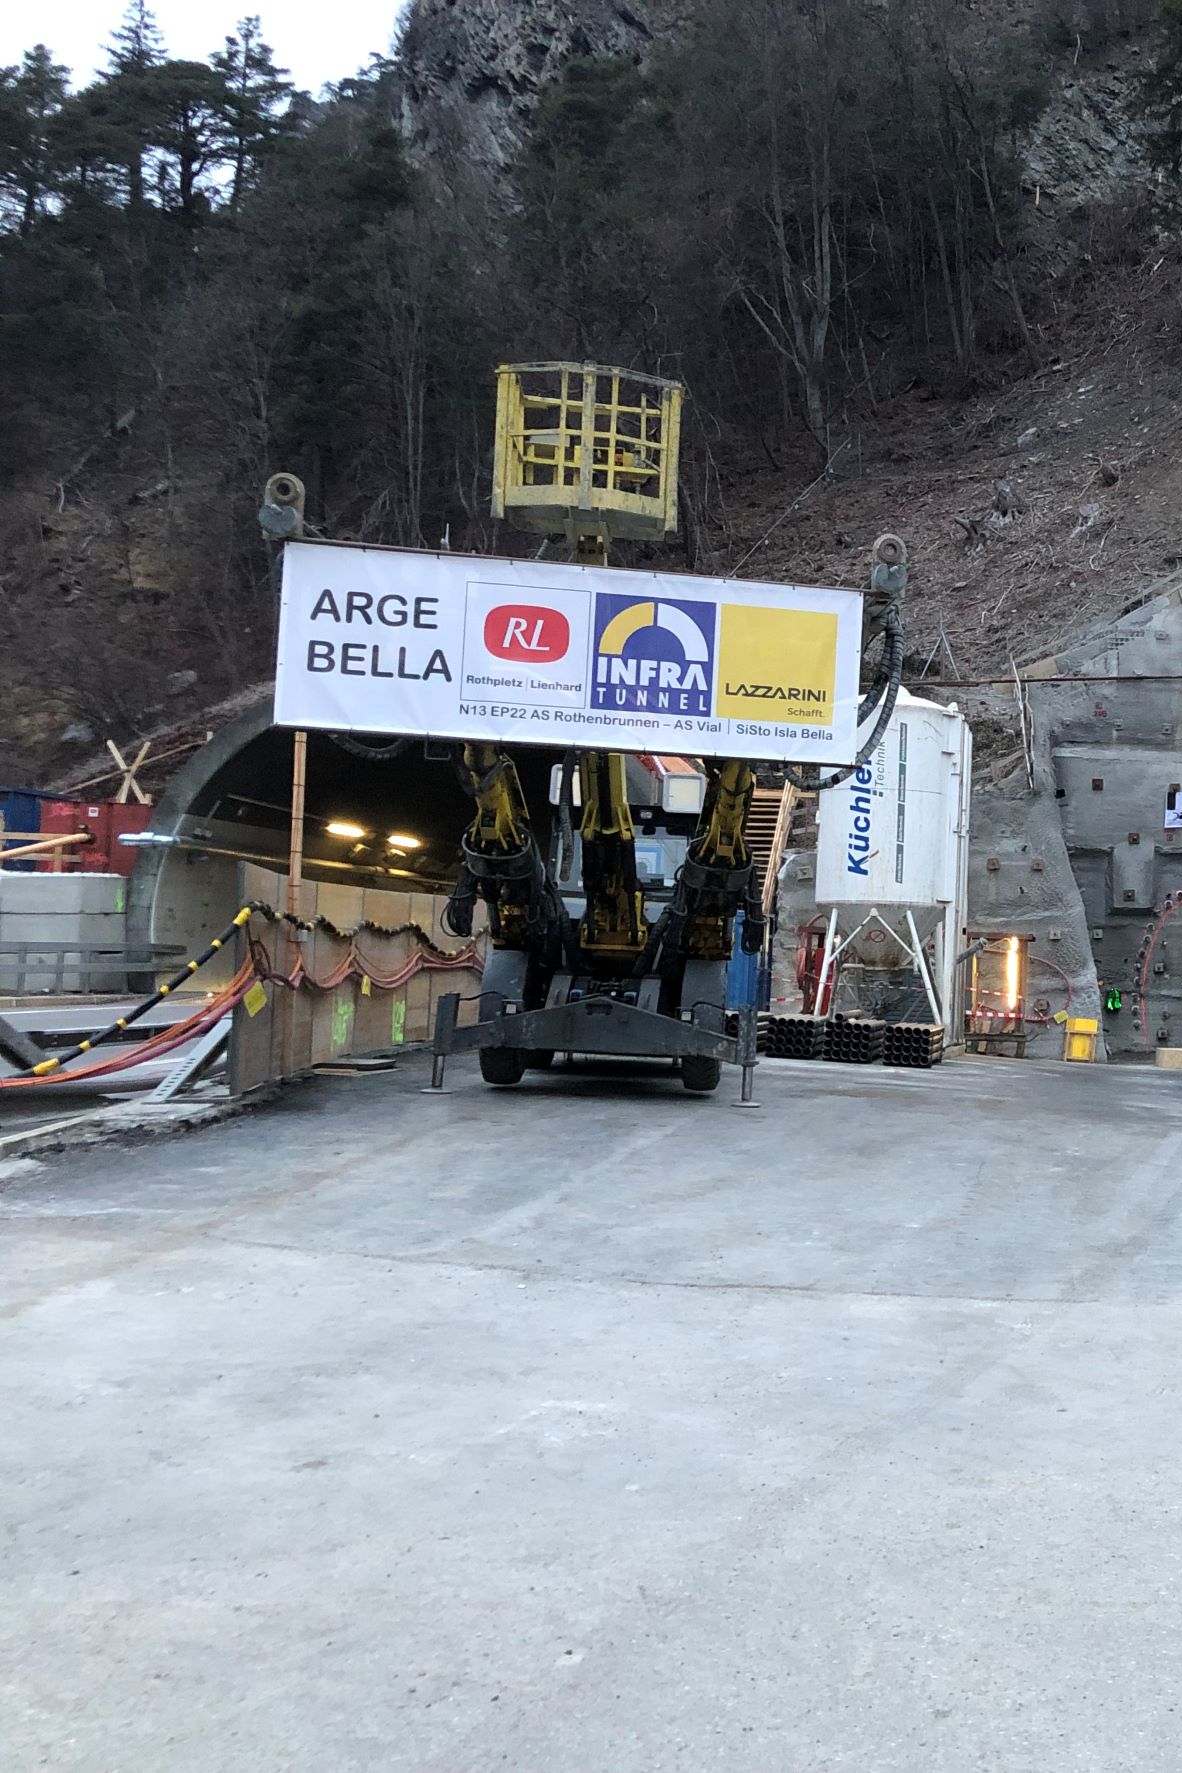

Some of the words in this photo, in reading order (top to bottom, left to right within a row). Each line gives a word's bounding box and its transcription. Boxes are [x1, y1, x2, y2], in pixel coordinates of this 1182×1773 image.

[310, 588, 439, 630] ARGE
[502, 616, 551, 651] RL
[306, 639, 453, 683] BELLA
[596, 656, 709, 691] INFRA
[465, 674, 524, 689] Rothpletz
[530, 678, 583, 693] Lienhard
[596, 687, 707, 711] TUNNEL
[725, 682, 827, 703] LAZZARINI
[458, 704, 488, 716] N13
[490, 706, 527, 719] EP22
[530, 709, 551, 721] AS
[553, 710, 660, 729] Rothenbrunnen
[673, 719, 694, 732] AS
[696, 720, 722, 733] Vial
[736, 724, 771, 738] SiSto
[774, 726, 798, 738] Isla
[800, 728, 833, 741] Bella
[875, 741, 886, 787] Technik
